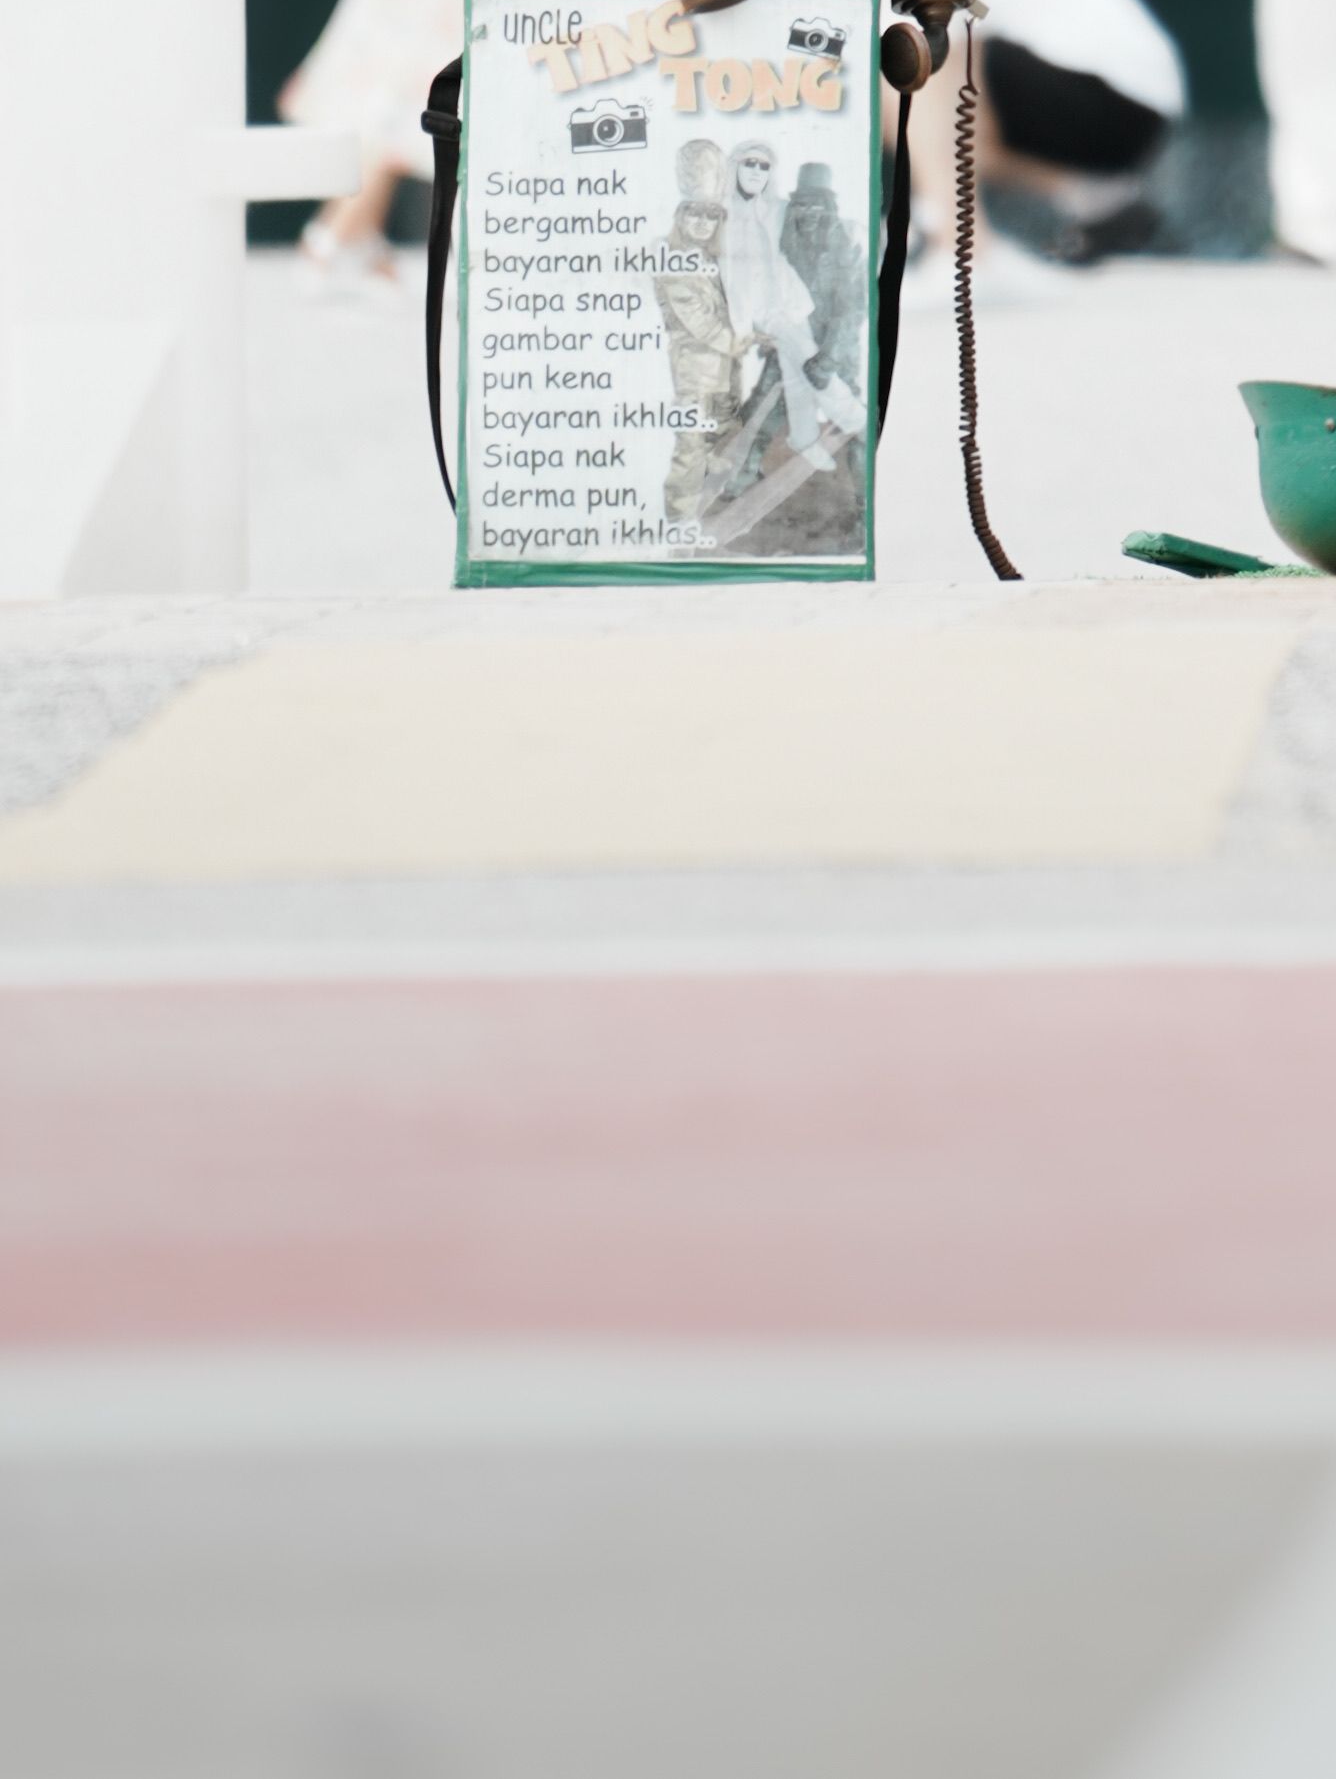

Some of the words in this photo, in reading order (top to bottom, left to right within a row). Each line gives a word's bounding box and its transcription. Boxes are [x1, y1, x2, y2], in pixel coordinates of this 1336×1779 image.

[659, 57, 844, 112] TONG
[485, 172, 566, 204] Siapa
[577, 169, 628, 195] nak
[485, 209, 647, 242] bergambar
[484, 248, 602, 281] bayaran
[614, 246, 717, 273] ikhlas..
[484, 288, 565, 320] Siapa
[576, 292, 642, 319] snap
[482, 325, 593, 359] gambar
[605, 325, 661, 351] curi
[483, 371, 532, 398] pun
[545, 363, 612, 390] kena
[483, 404, 601, 437] bayaran
[613, 402, 716, 429] ikhlas..
[483, 444, 564, 476] Siapa
[575, 441, 626, 468] nak
[482, 481, 576, 508] derma
[587, 487, 646, 515] pun,
[482, 520, 600, 555] bayaran
[611, 519, 715, 546] ikhlas..
